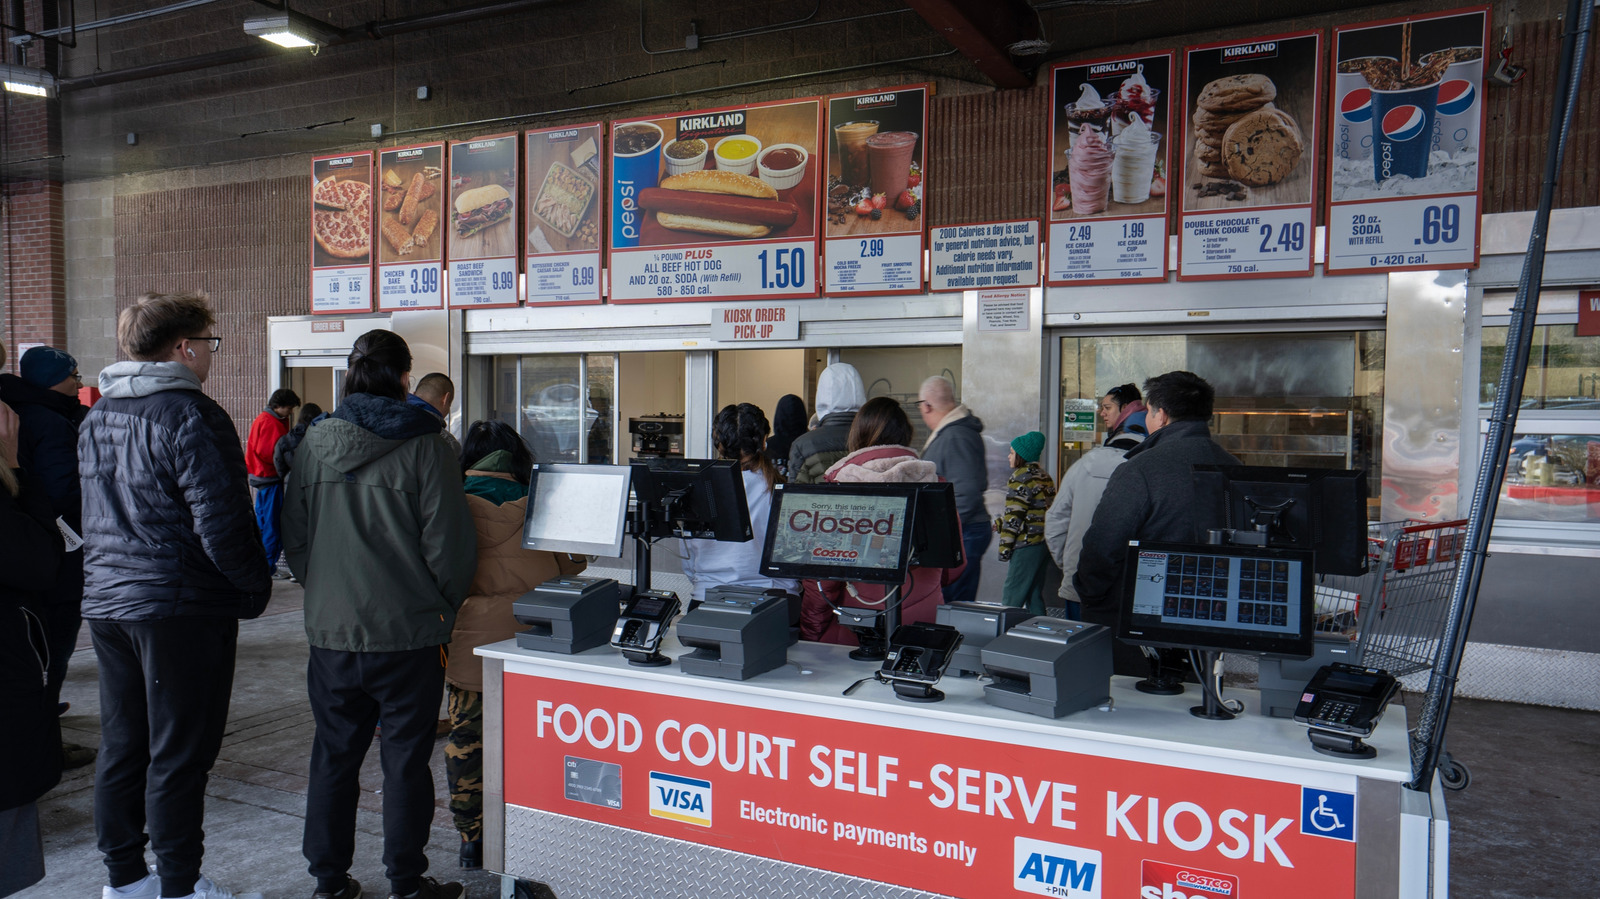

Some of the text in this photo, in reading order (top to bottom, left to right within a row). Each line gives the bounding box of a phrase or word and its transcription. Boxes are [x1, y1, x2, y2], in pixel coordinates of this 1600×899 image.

[1224, 43, 1276, 57] KIRKLAND
[1090, 61, 1136, 74] KIRKLAND
[857, 94, 895, 105] KIRKLAND
[680, 113, 744, 131] KIRKLAND
[549, 130, 577, 139] KIRKLAND
[680, 128, 744, 140] Signature
[469, 141, 495, 149] KIRKLAND
[1339, 124, 1351, 159] pepsi
[1381, 142, 1394, 178] pepsi
[618, 180, 639, 239] pepsi
[1185, 217, 1260, 228] DOUBLE CHOCOLATE
[1352, 214, 1365, 224] 20
[1414, 204, 1460, 245] .69
[940, 228, 956, 239] 2000
[959, 227, 984, 238] Calories
[993, 225, 1004, 236] day
[1006, 224, 1011, 234] is
[1013, 223, 1029, 234] used
[1070, 222, 1144, 241] 2.49 1.99
[1194, 227, 1220, 236] CHUNK
[1352, 224, 1381, 235] SODA
[935, 235, 1034, 252] for general nutrition advice, but
[1260, 222, 1304, 253] 2.49
[1349, 236, 1384, 245] WITH REFILL
[661, 252, 683, 261] POUND
[684, 249, 713, 259] PLUS
[860, 239, 883, 258] 2.99
[954, 250, 1013, 262] calorie needs vary.
[1408, 254, 1428, 264] cal.
[644, 260, 722, 273] ALL BEEF HOT DOG
[758, 247, 805, 289] 1.50
[936, 261, 1032, 275] Additional nutrition information
[410, 267, 437, 294] 3.99
[492, 271, 513, 290] 9.99
[572, 267, 594, 286] 6.99
[629, 272, 742, 285] AND 20 oz. SODA (With Refill)
[947, 274, 1020, 287] available upon request.
[329, 281, 360, 293] 1.99 9.95
[657, 286, 672, 296] 580
[680, 285, 696, 295] 850
[697, 285, 712, 294] cal.
[724, 308, 785, 323] KIOSK ORDER
[734, 325, 773, 339] PICK-UP
[789, 510, 894, 536] Closed
[813, 547, 858, 558] COSTCO
[536, 700, 643, 753] FOOD
[655, 720, 795, 780] COURT
[1106, 790, 1294, 869] KIOSK
[606, 799, 620, 807] VISA
[656, 786, 704, 813] VISA
[740, 800, 977, 867] Electronic payments only
[1018, 852, 1097, 892] ATM
[1176, 871, 1232, 890] COSTCO
[1045, 886, 1068, 897] +PIN
[1194, 884, 1230, 894] WHOLESALE
